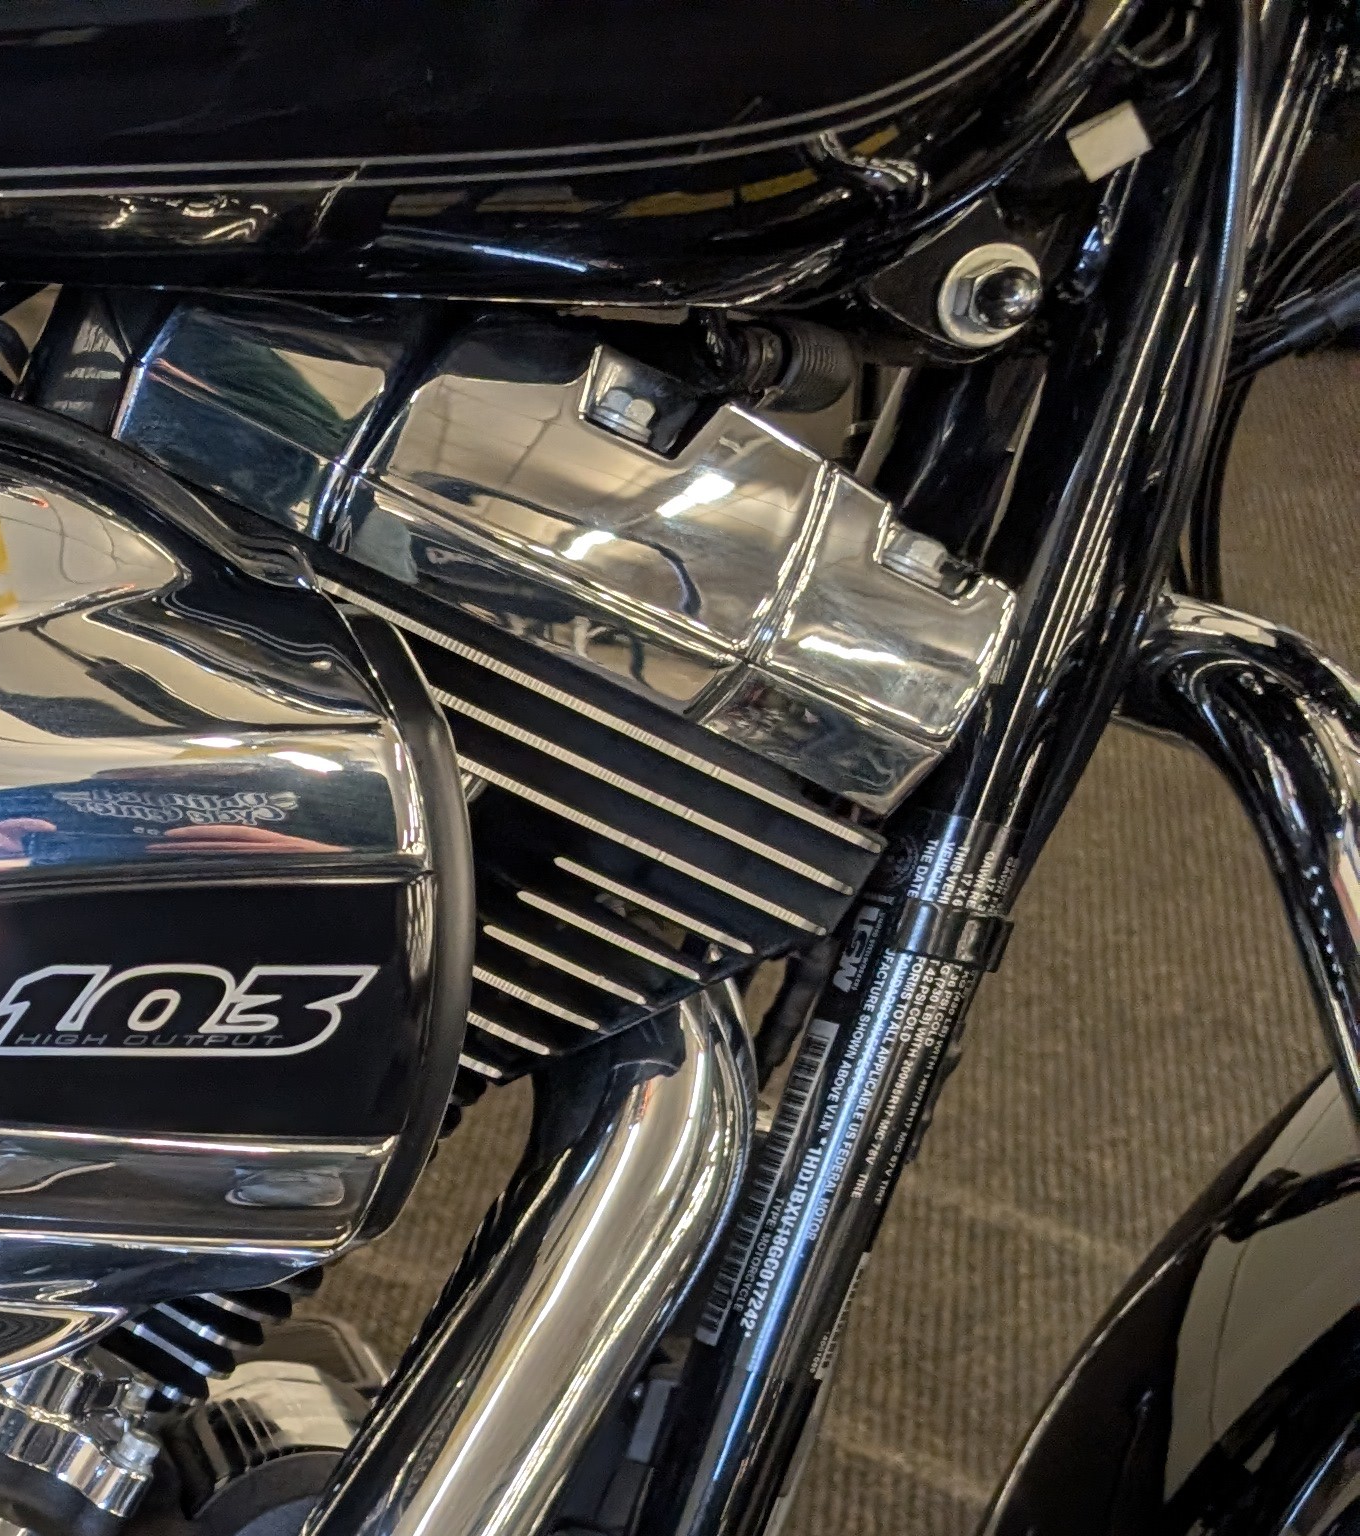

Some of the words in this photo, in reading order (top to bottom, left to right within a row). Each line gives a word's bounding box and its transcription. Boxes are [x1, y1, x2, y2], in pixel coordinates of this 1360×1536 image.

[918, 836, 940, 865] THE
[948, 843, 971, 874] THIS
[904, 864, 930, 900] DATE
[959, 871, 975, 886] 17
[971, 849, 997, 890] GAWR
[935, 874, 959, 906] VEHI
[963, 889, 981, 910] RE
[876, 952, 913, 1021] TANDARDS
[898, 955, 927, 1001] FORMS
[920, 966, 938, 984] 42
[927, 977, 947, 1003] (730
[891, 1000, 909, 1021] TO
[912, 984, 931, 1006] PSI
[936, 989, 953, 1011] PSI
[14, 1033, 109, 1046] HIGH
[123, 1033, 284, 1047] OUTPUT
[842, 1012, 872, 1060] SHOWN
[881, 1021, 901, 1047] ALL
[897, 1006, 922, 1043] COLD
[921, 1010, 945, 1048] COLD
[825, 1059, 853, 1103] ABOVE
[851, 1046, 891, 1122] APPLICABLE
[843, 1121, 861, 1141] US
[821, 1140, 854, 1198] FEDERAL
[804, 1197, 832, 1242] MOTOR
[731, 1230, 772, 1312] MOTORCYCLE
